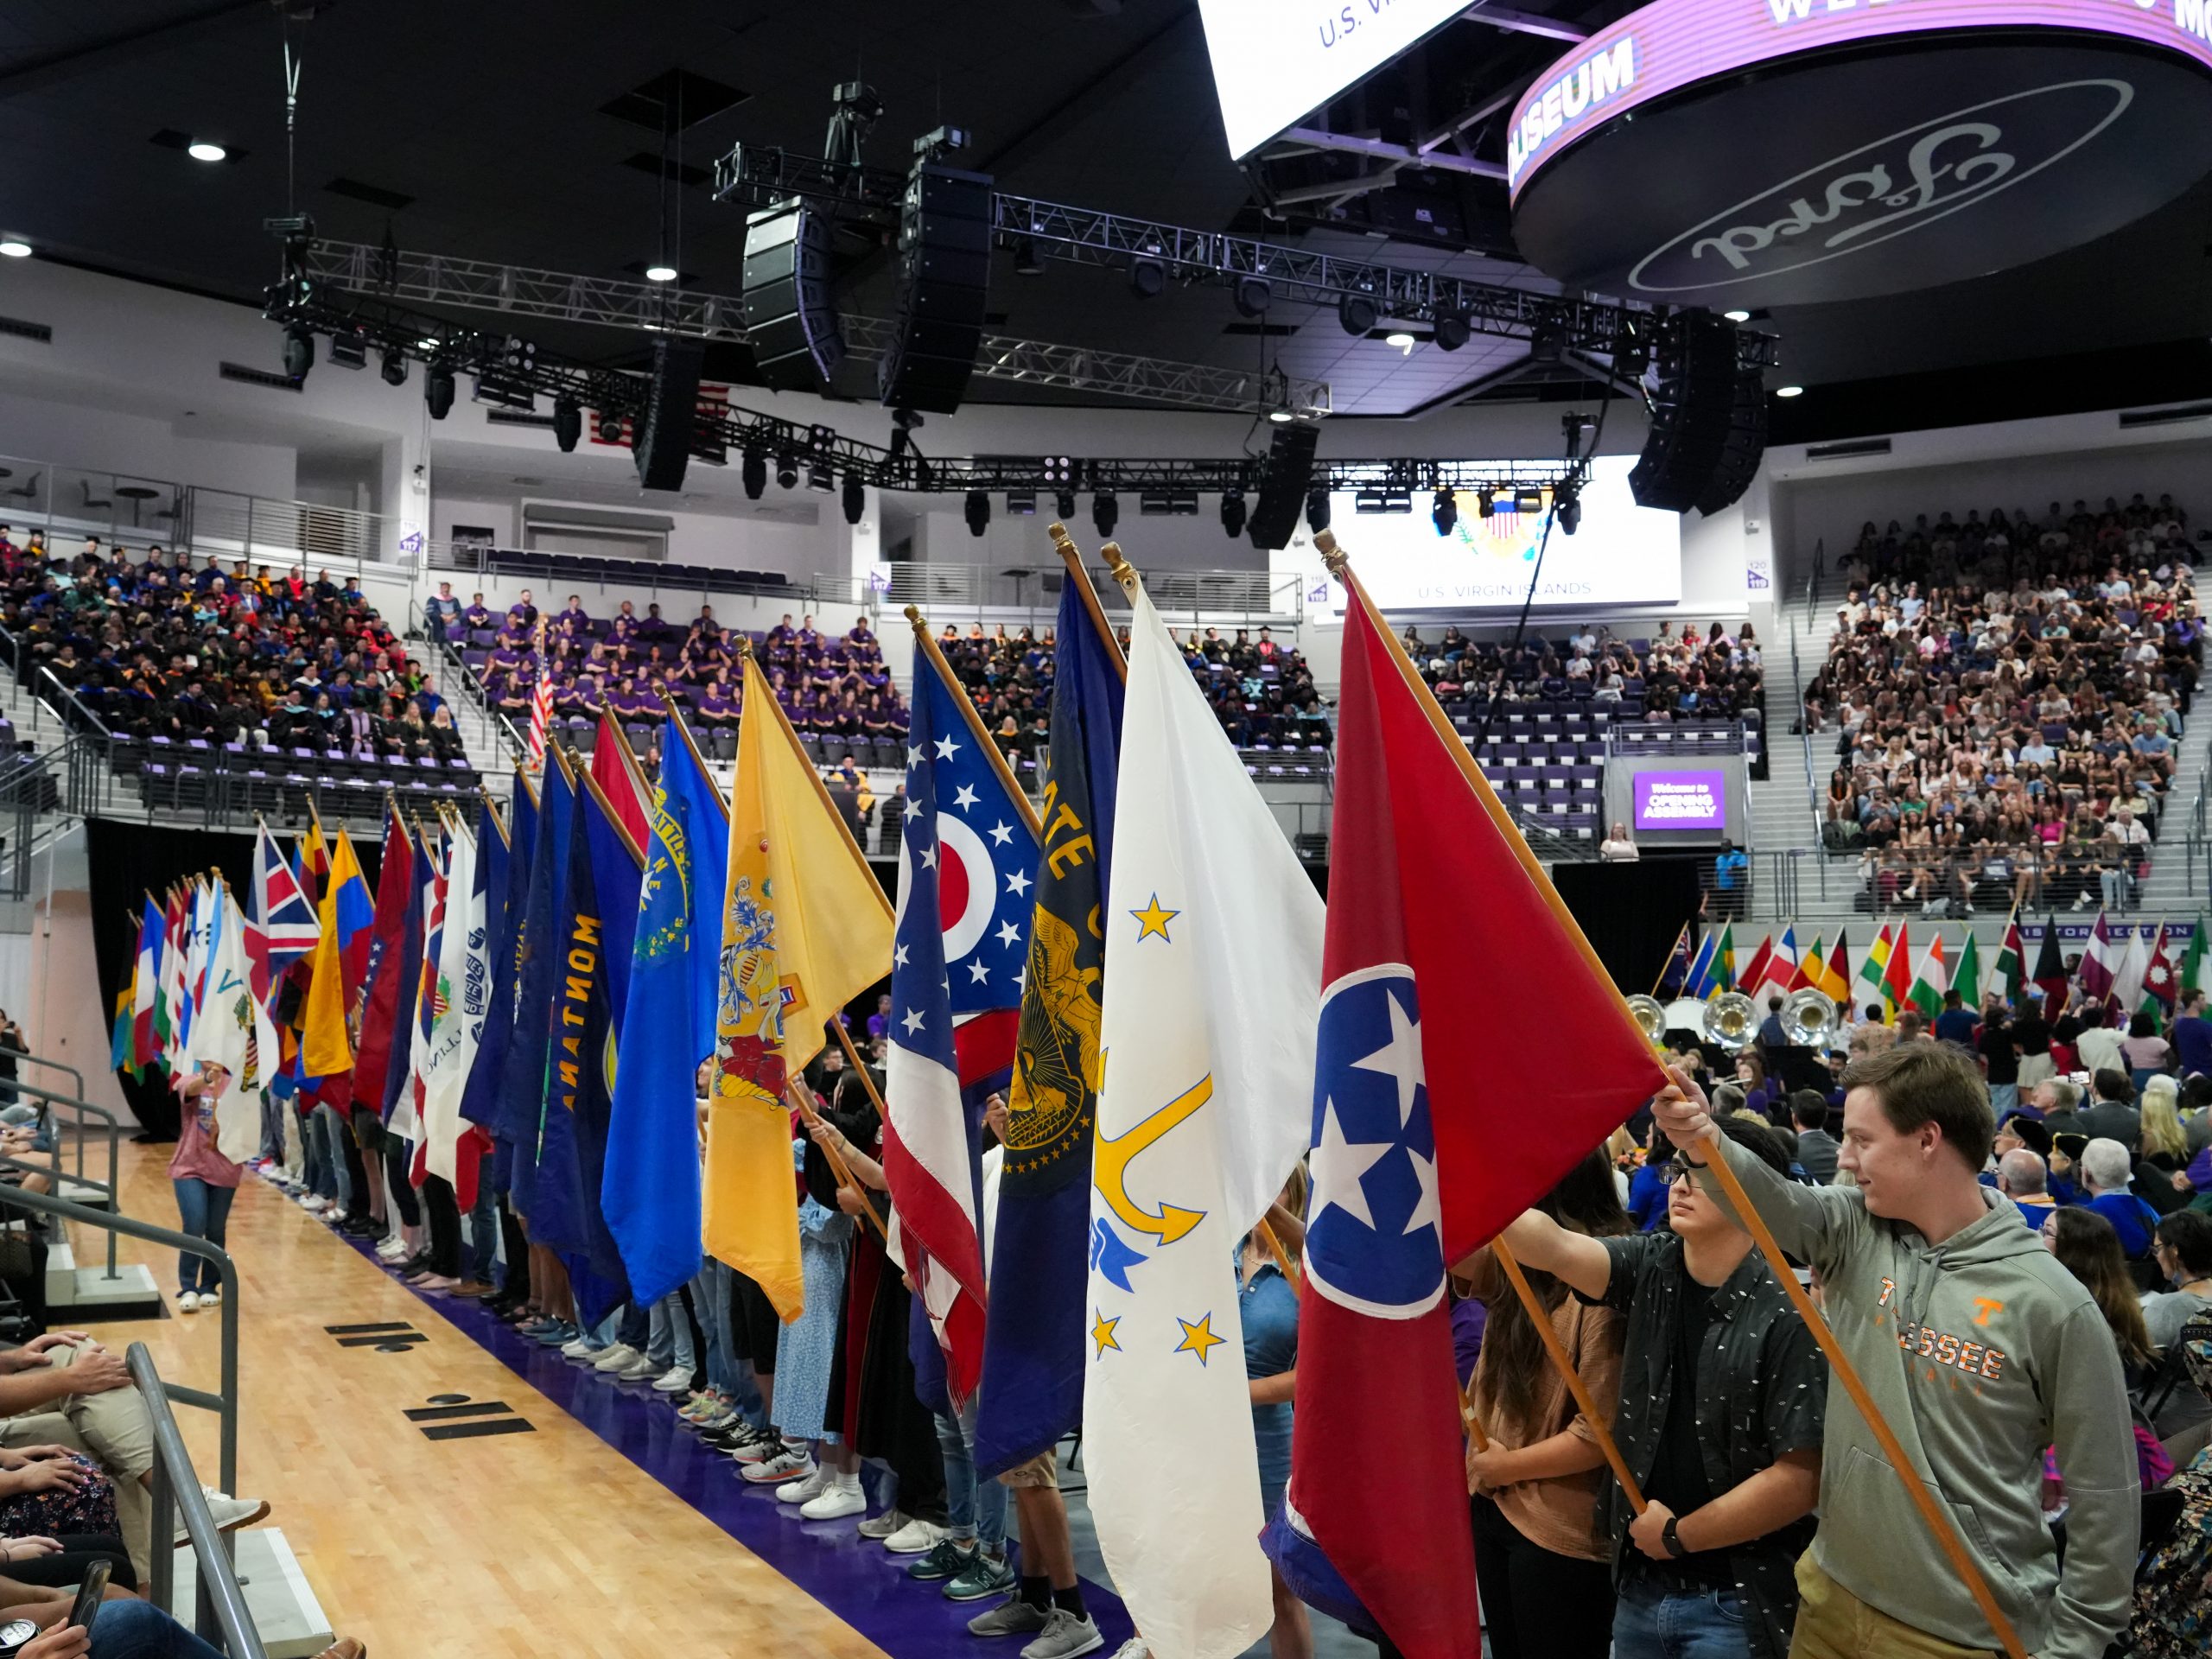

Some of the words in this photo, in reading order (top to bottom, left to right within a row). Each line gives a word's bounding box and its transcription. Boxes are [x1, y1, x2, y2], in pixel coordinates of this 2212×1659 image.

[1319, 6, 1361, 48] U.S.
[1507, 36, 1634, 188] OLISEUM
[1691, 122, 2016, 270] Ford
[403, 541, 418, 551] 117
[1455, 584, 1512, 597] VIRGIN
[1519, 582, 1592, 595] ISLANDS
[1649, 794, 1713, 807] OPENING
[1643, 805, 1717, 818] ASSEMBLY
